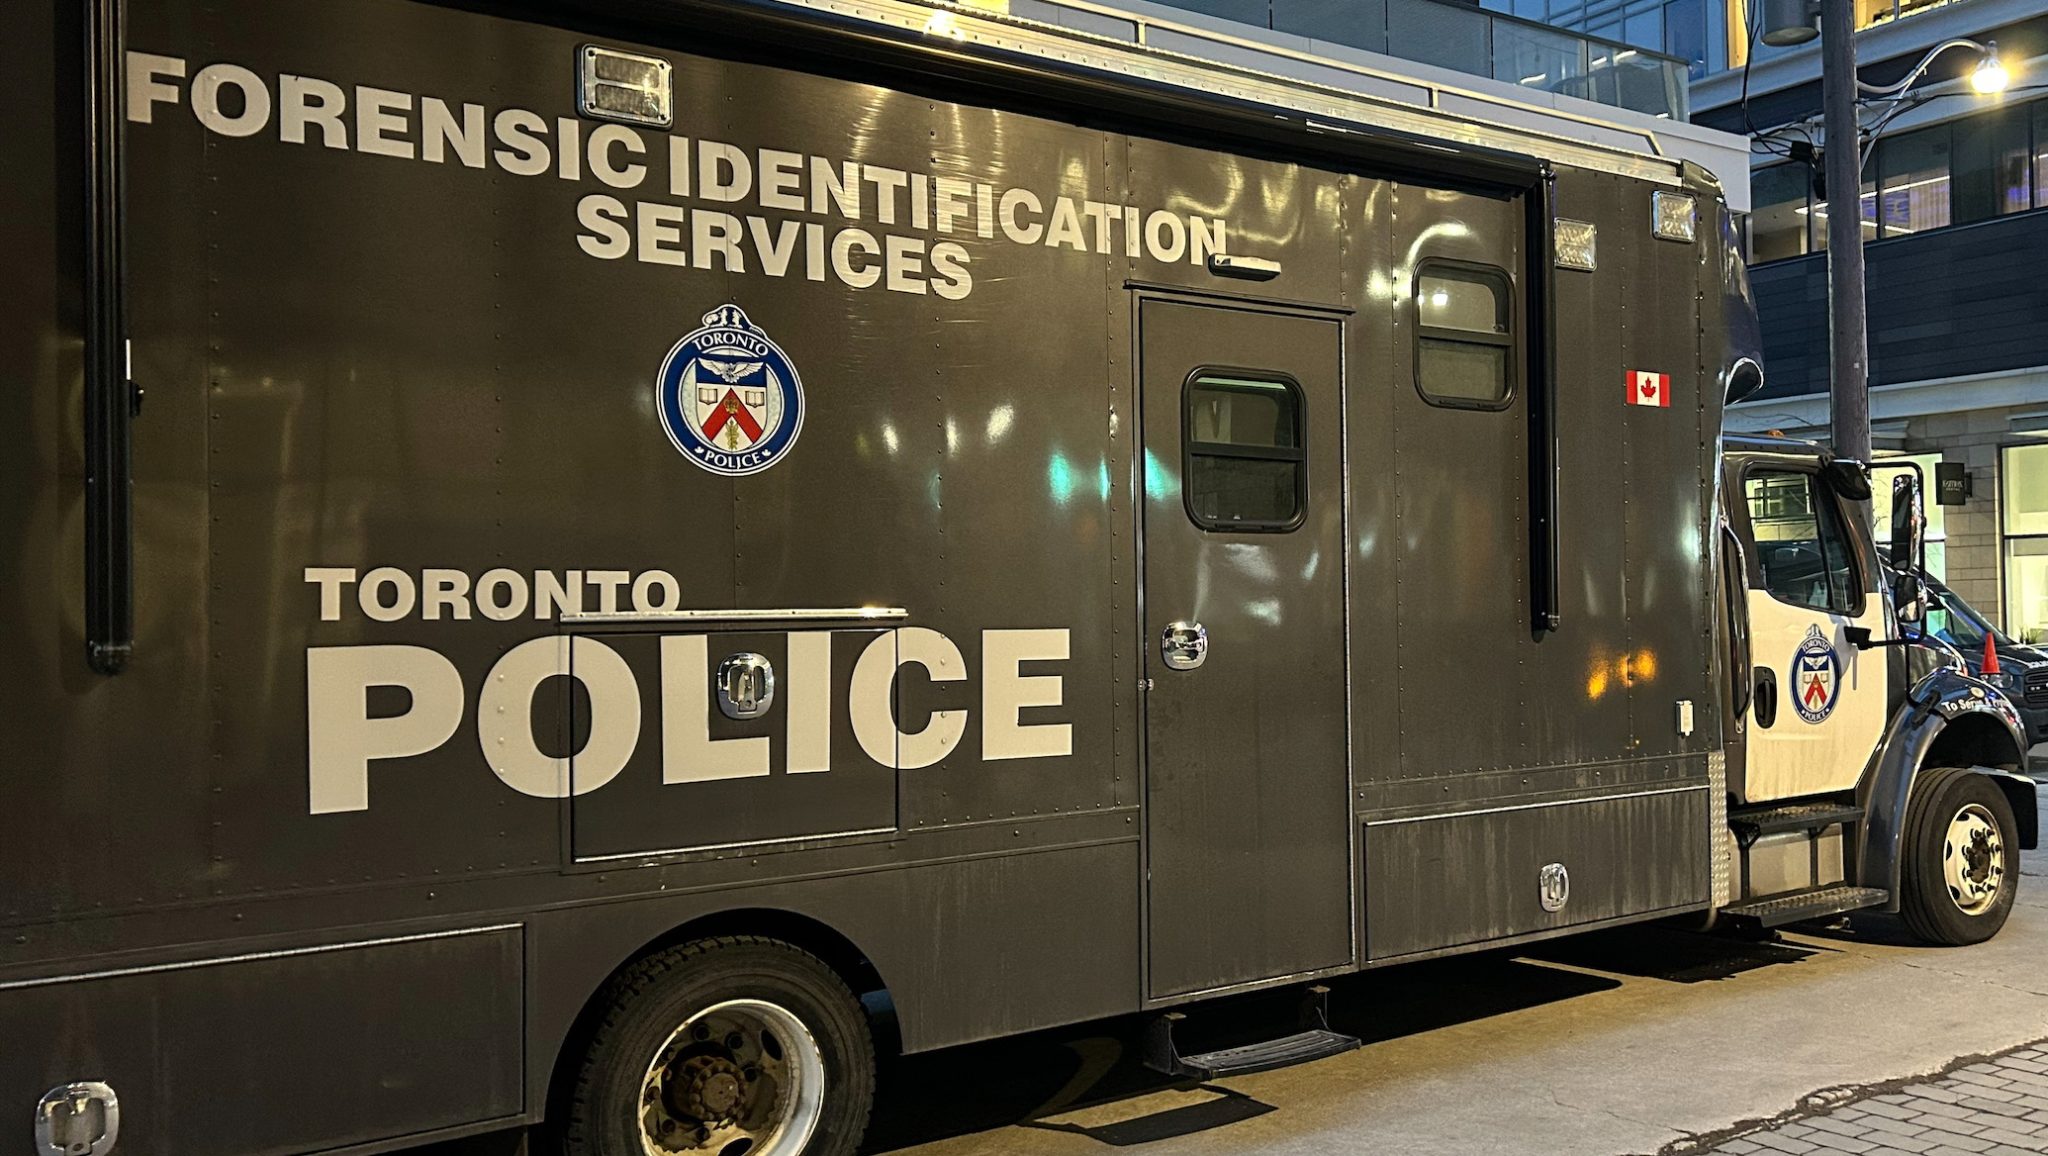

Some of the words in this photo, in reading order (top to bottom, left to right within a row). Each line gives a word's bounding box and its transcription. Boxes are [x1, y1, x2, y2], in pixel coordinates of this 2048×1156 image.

[126, 50, 647, 189] FORENSIC
[669, 135, 1227, 266] IDENTIFICATION
[576, 194, 973, 300] SERVICES
[692, 332, 769, 356] TORONTO
[704, 449, 762, 469] POLICE
[304, 567, 681, 621] TORONTO
[307, 626, 1073, 815] POLICE
[1941, 701, 1958, 712] To
